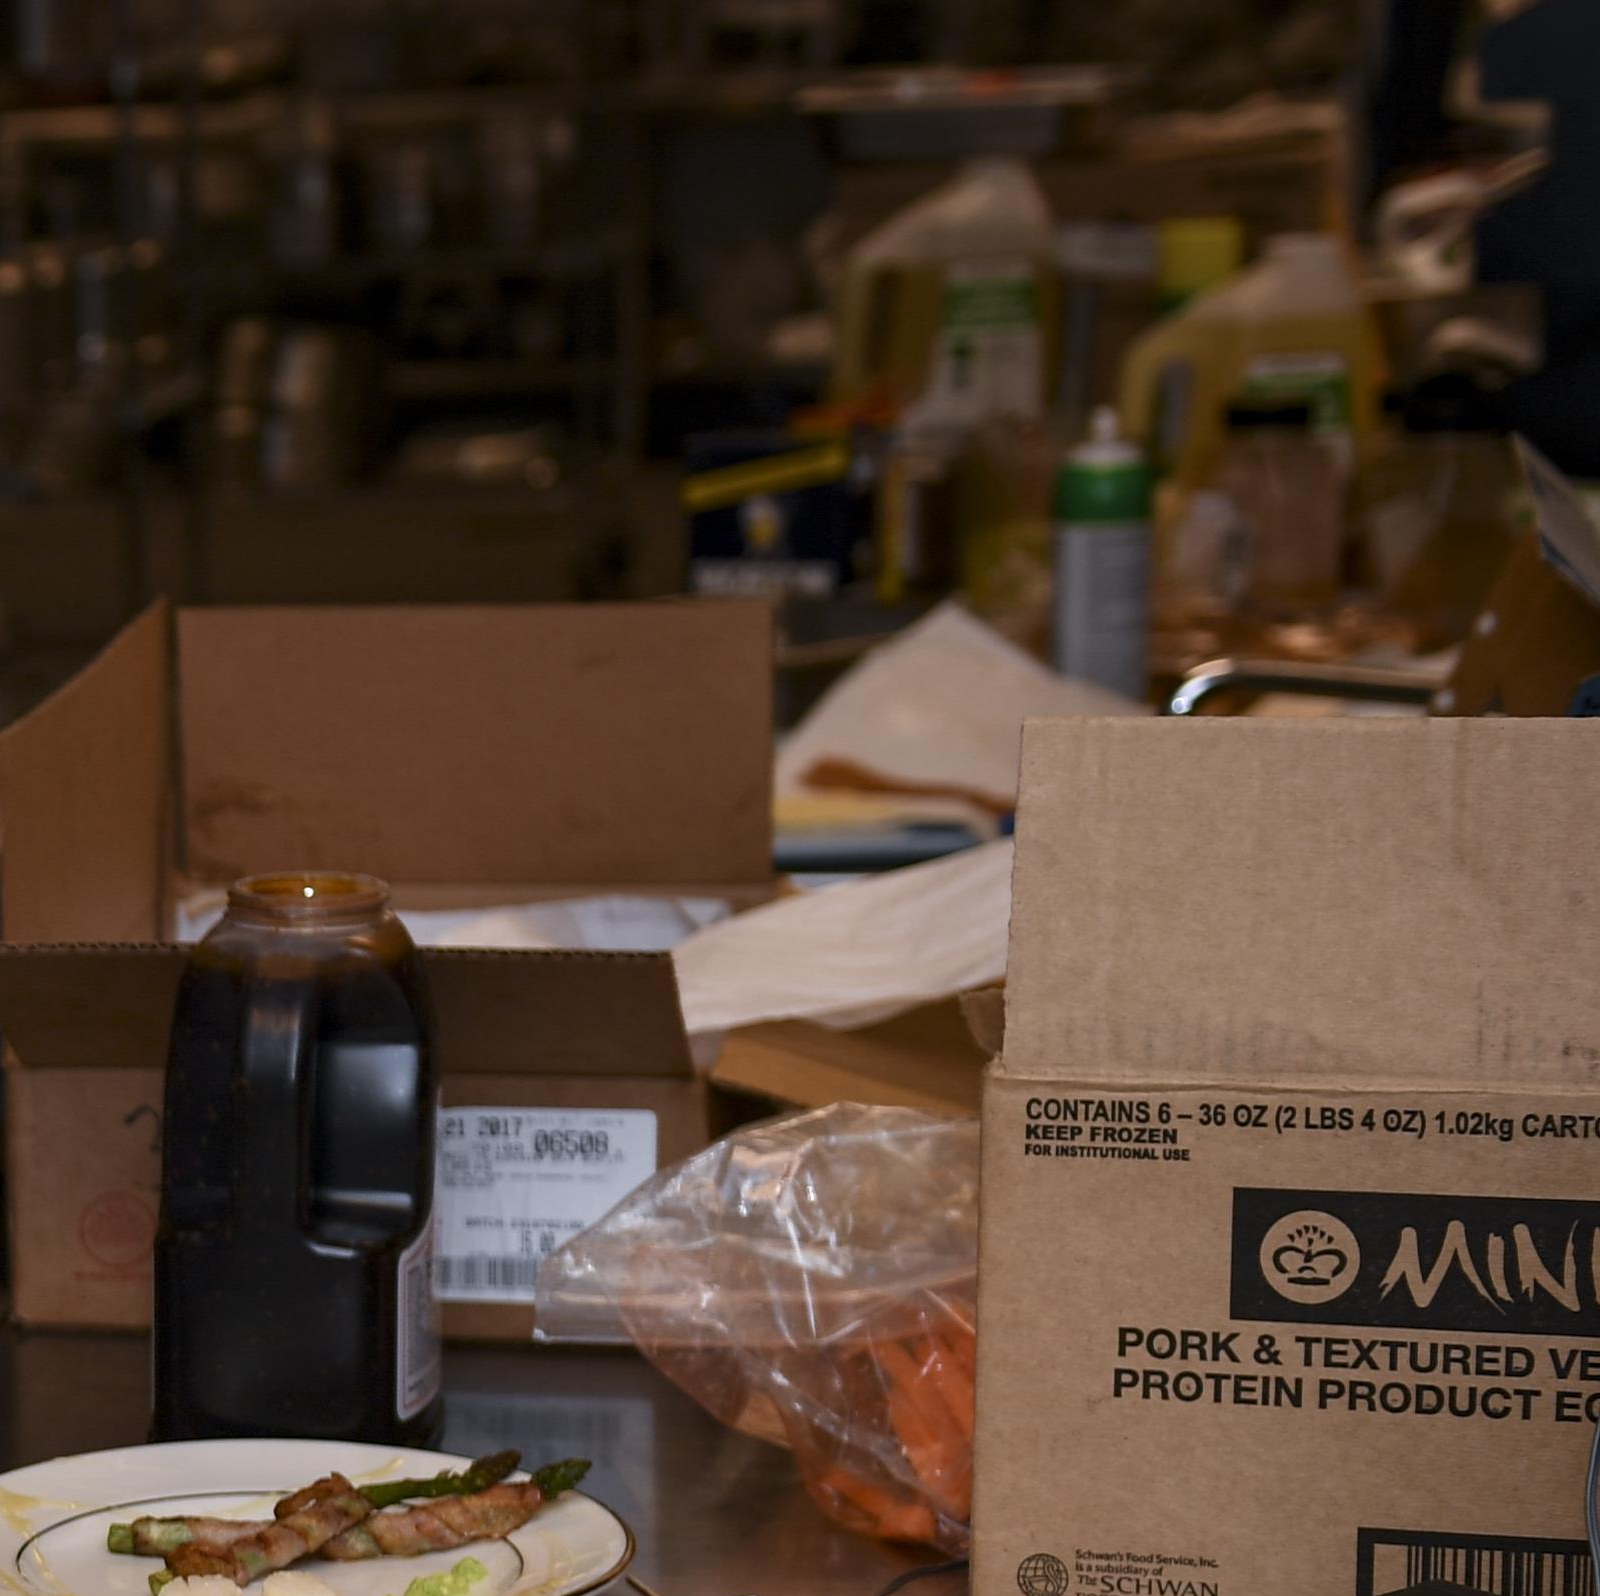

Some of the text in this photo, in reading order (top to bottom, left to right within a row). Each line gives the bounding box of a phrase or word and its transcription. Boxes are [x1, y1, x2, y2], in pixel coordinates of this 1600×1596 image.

[478, 1116, 522, 1136] 2017
[1026, 1098, 1151, 1124] CONTAINS
[1158, 1103, 1171, 1124] 6
[1198, 1104, 1226, 1126] 36
[1233, 1105, 1268, 1127] OZ
[1275, 1105, 1297, 1134] (2
[1304, 1107, 1353, 1131] LBS
[1361, 1109, 1375, 1131] 4
[1383, 1109, 1426, 1139] OZ)
[1435, 1111, 1514, 1142] 1.02kg
[1025, 1124, 1178, 1144] KEEP FROZEN
[1025, 1144, 1190, 1161] FOR INSTITUTIONAL USE
[1117, 1327, 1241, 1363] PORK
[1253, 1334, 1283, 1365] &
[1295, 1335, 1535, 1378] TEXTURED
[1113, 1368, 1303, 1408] PROTEIN
[1318, 1378, 1542, 1421] PRODUCT
[1075, 1550, 1219, 1568] Schwan's Food Service, Inc.
[1086, 1564, 1092, 1573] a
[1095, 1563, 1149, 1577] subsidiary
[1152, 1566, 1163, 1576] of
